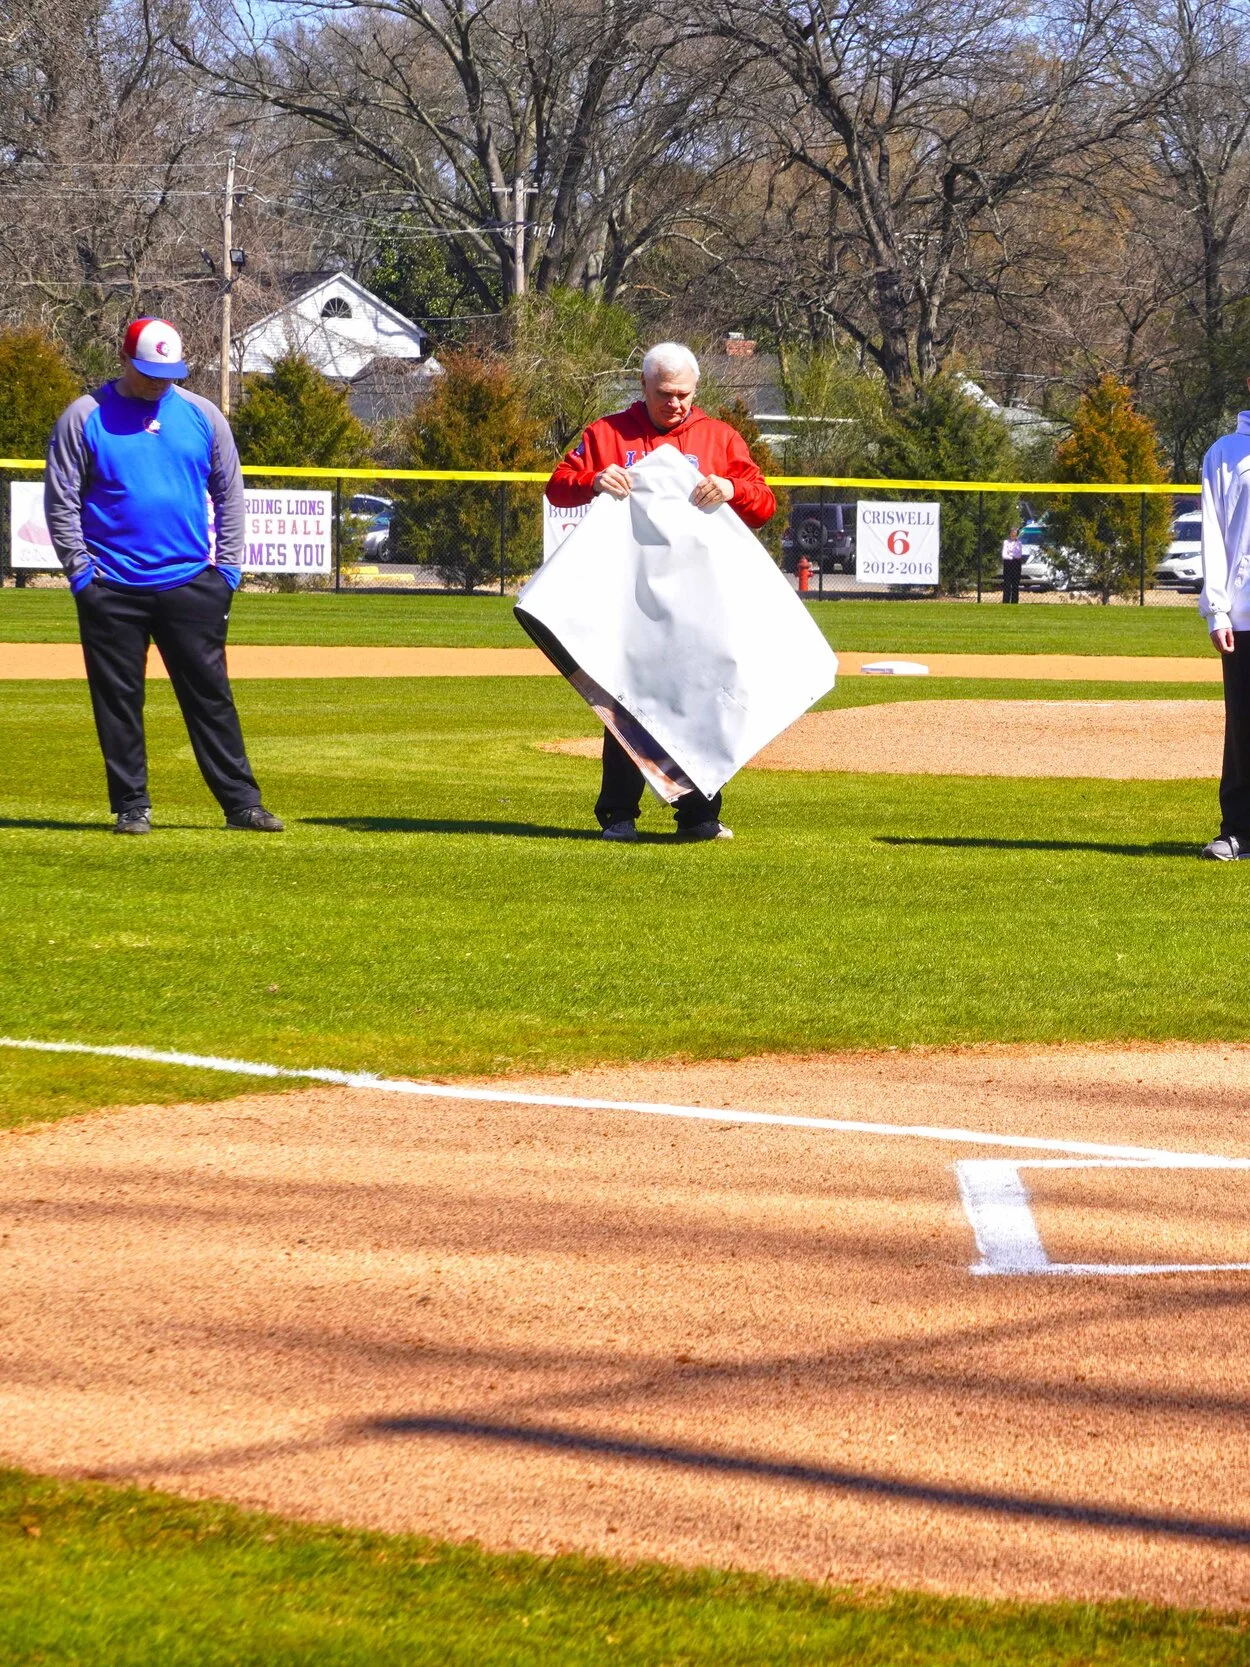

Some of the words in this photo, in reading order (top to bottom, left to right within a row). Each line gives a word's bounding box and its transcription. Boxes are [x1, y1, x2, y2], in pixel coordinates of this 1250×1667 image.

[287, 500, 324, 515] LIONS
[862, 510, 934, 526] CRISWELL
[245, 519, 324, 535] SEBALL
[887, 530, 910, 555] 6
[293, 543, 324, 566] YOU
[863, 561, 932, 575] 2012-2016
